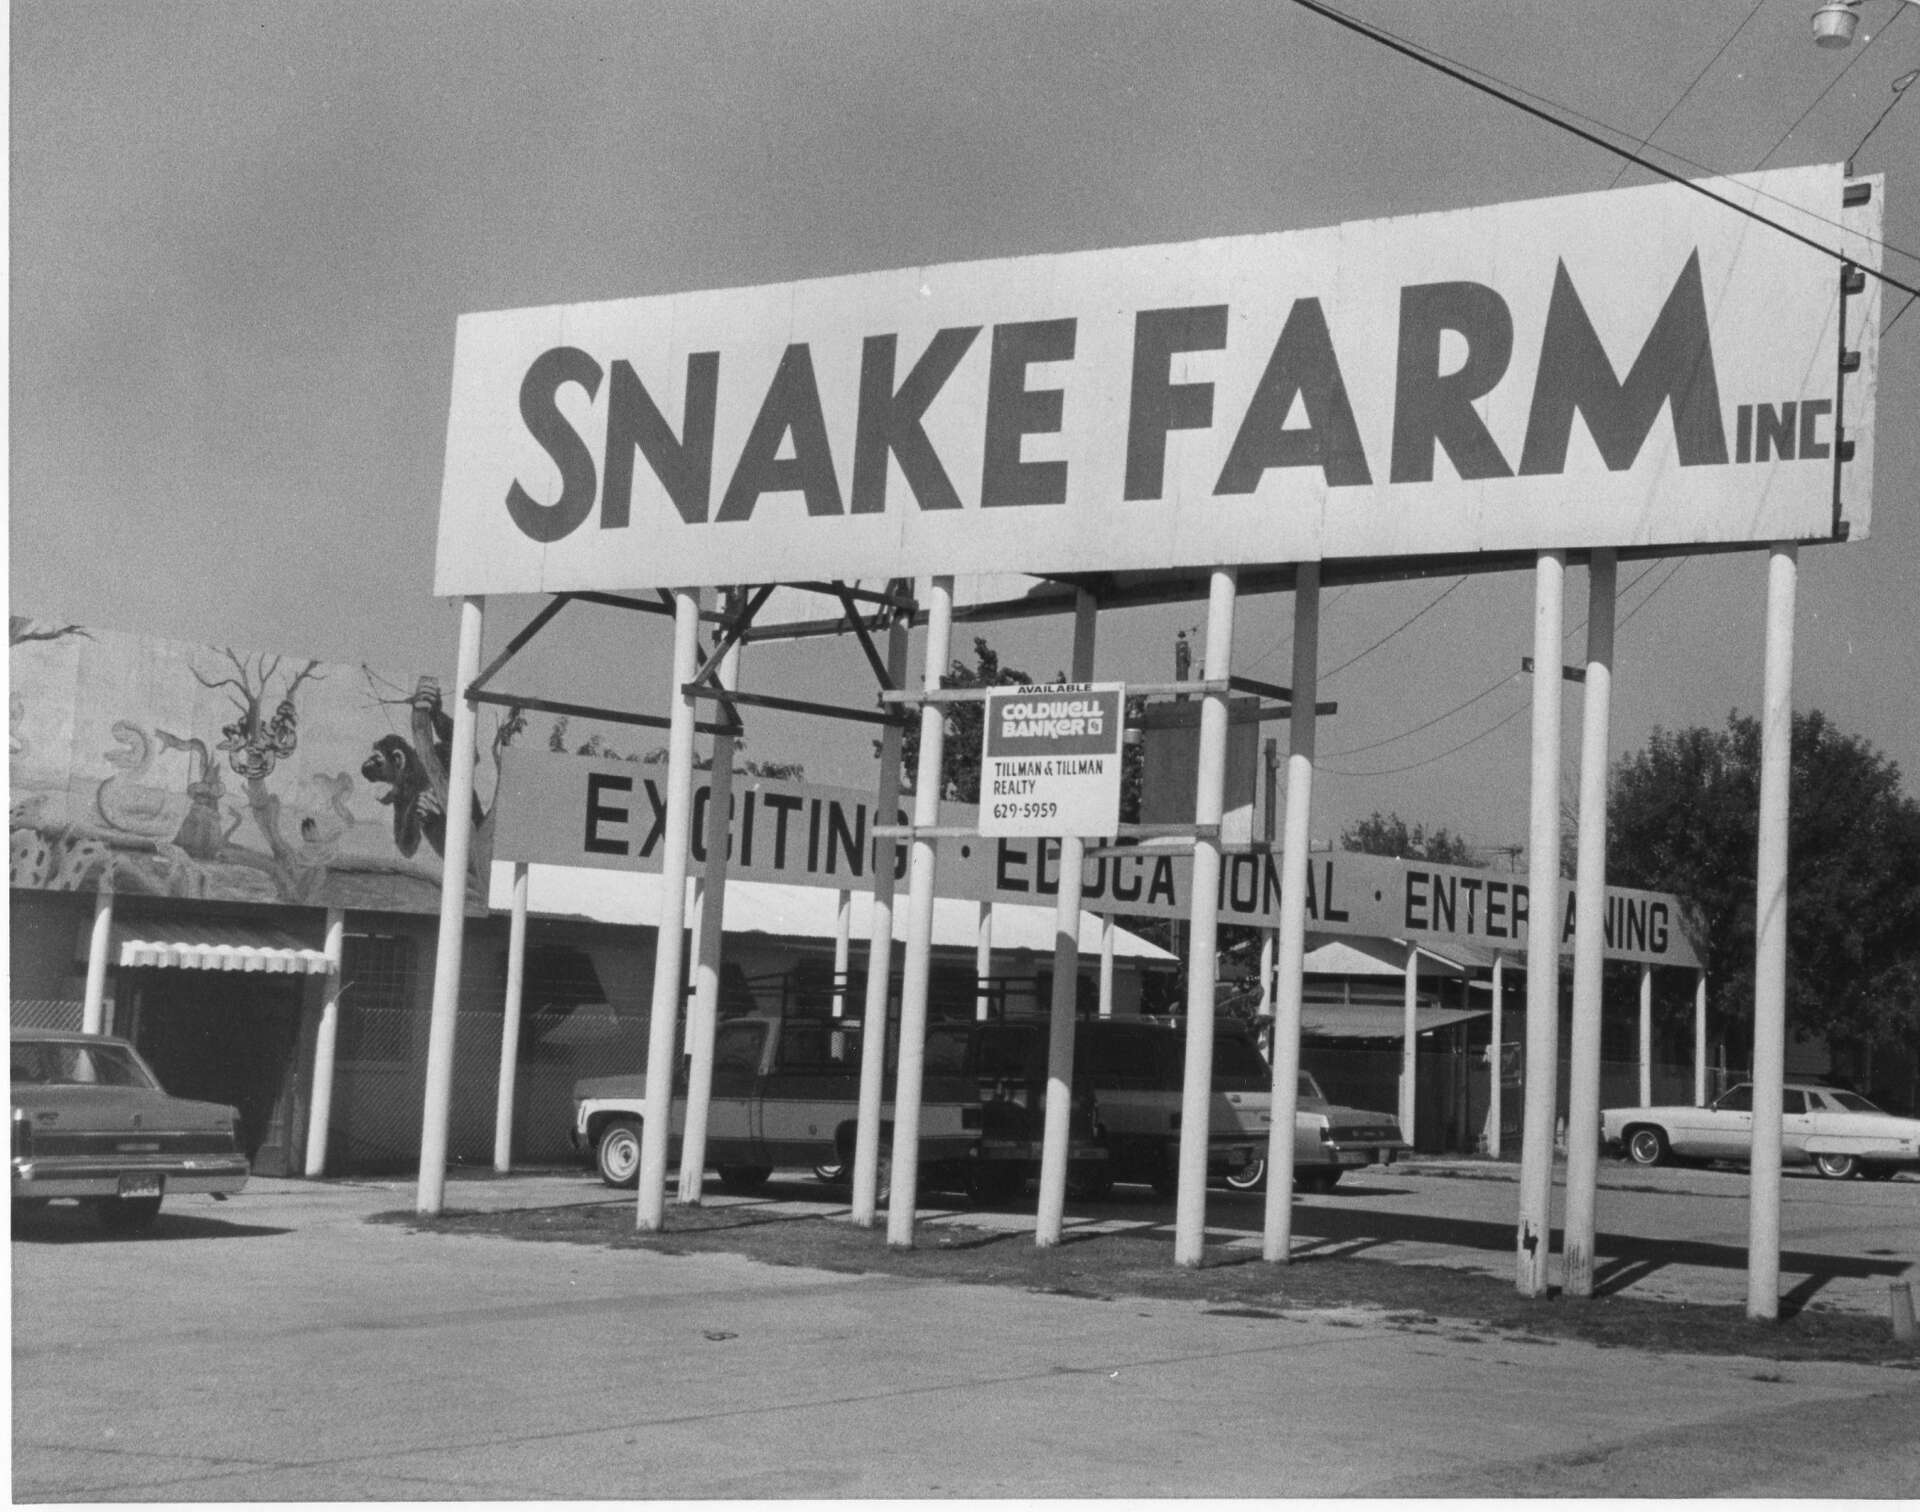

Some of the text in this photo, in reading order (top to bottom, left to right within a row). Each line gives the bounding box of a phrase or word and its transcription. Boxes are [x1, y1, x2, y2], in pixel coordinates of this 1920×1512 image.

[506, 247, 1832, 543] SNAKE FARM INC
[1017, 684, 1092, 694] AVAILABLE
[1002, 701, 1104, 720] COLDWELL
[1002, 718, 1085, 738] BANKER
[995, 760, 1103, 777] TILLMAN & TILLMAN
[994, 779, 1036, 795] REALTY
[996, 836, 1349, 922] EDUCAIONAL
[1405, 871, 1668, 953] ENTERANING
